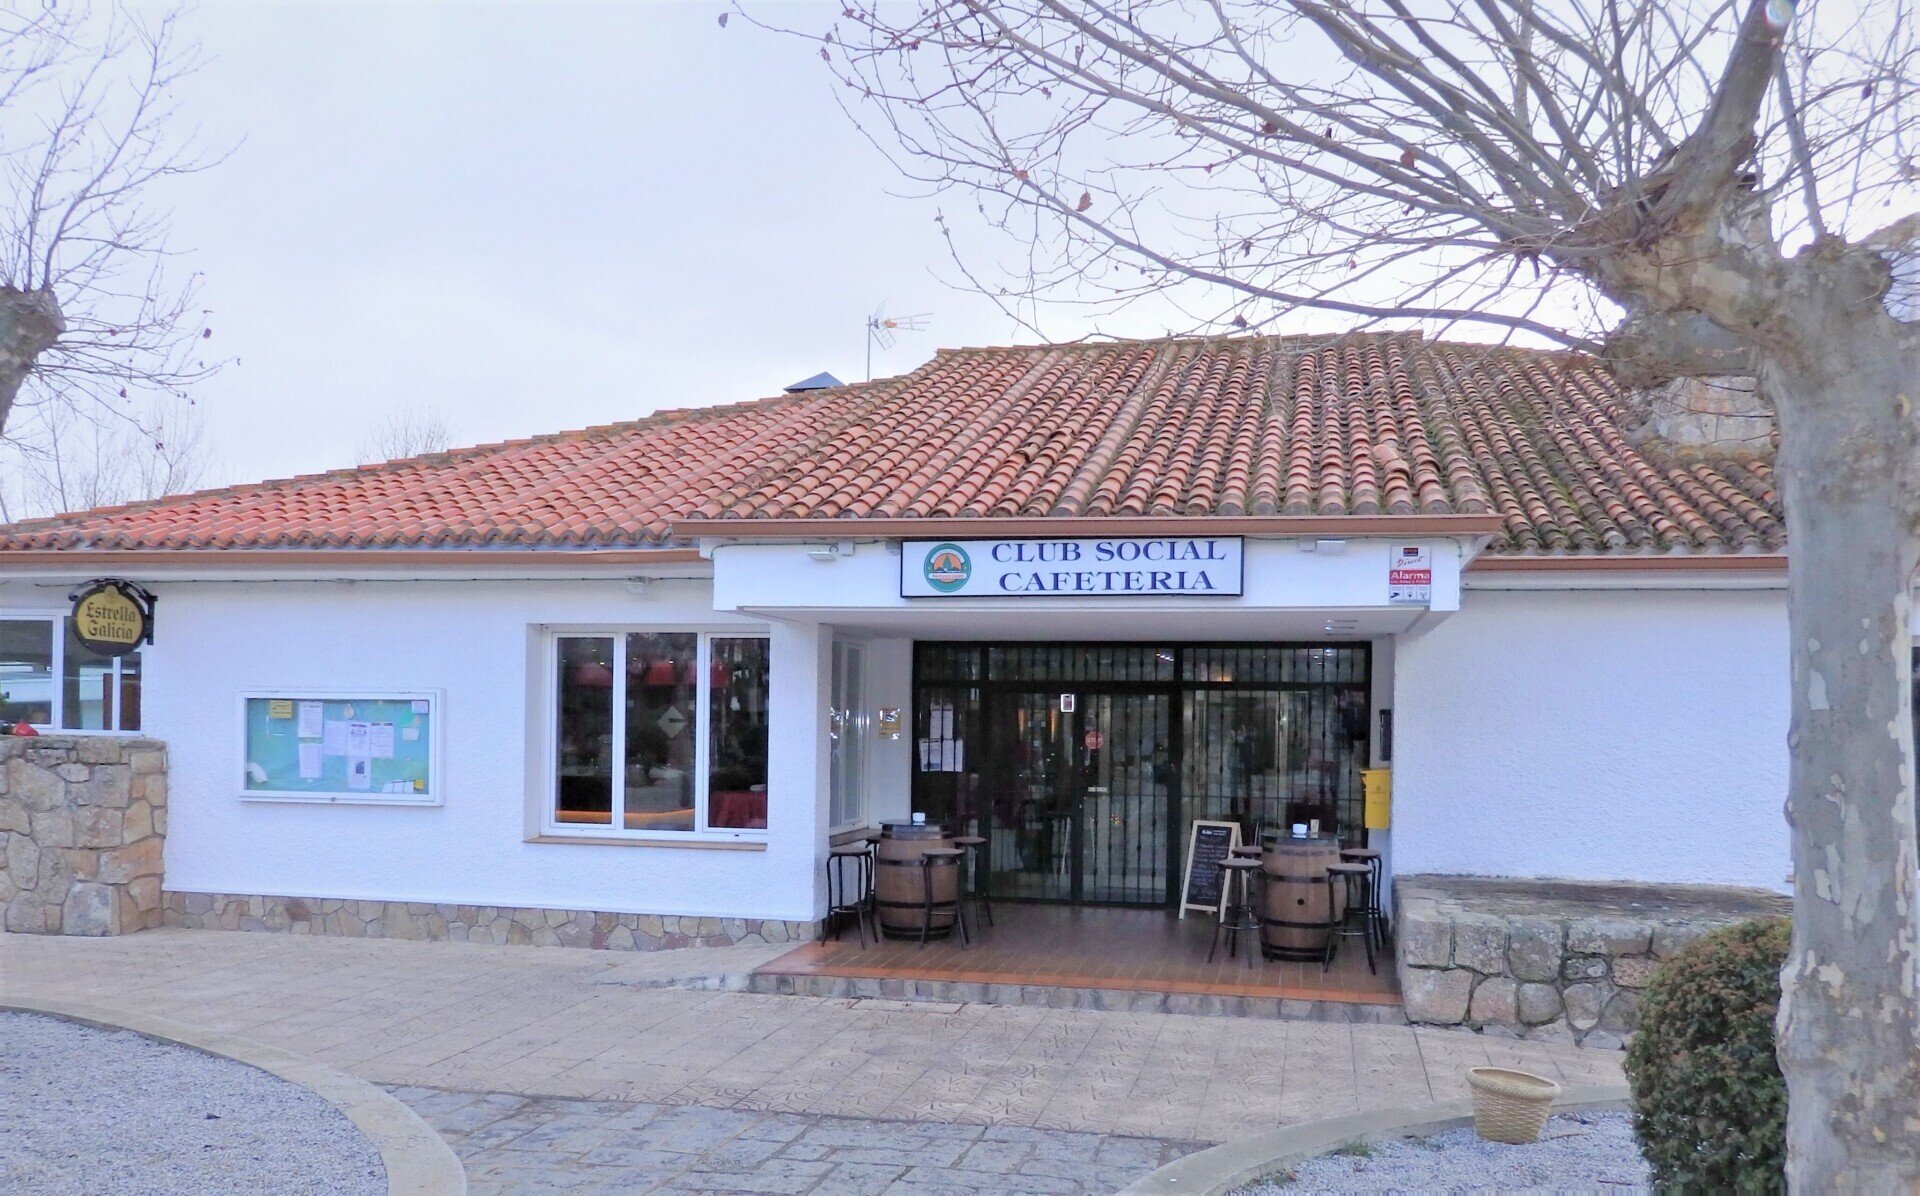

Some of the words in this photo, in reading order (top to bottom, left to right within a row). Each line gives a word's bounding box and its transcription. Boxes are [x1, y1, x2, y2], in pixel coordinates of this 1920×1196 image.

[991, 542, 1082, 562] CLUB
[1095, 540, 1227, 561] SOCIAL
[999, 570, 1216, 592] CAFETERIA
[1391, 571, 1430, 580] Alarma
[86, 602, 136, 622] Estrella
[88, 620, 133, 639] Galicia
